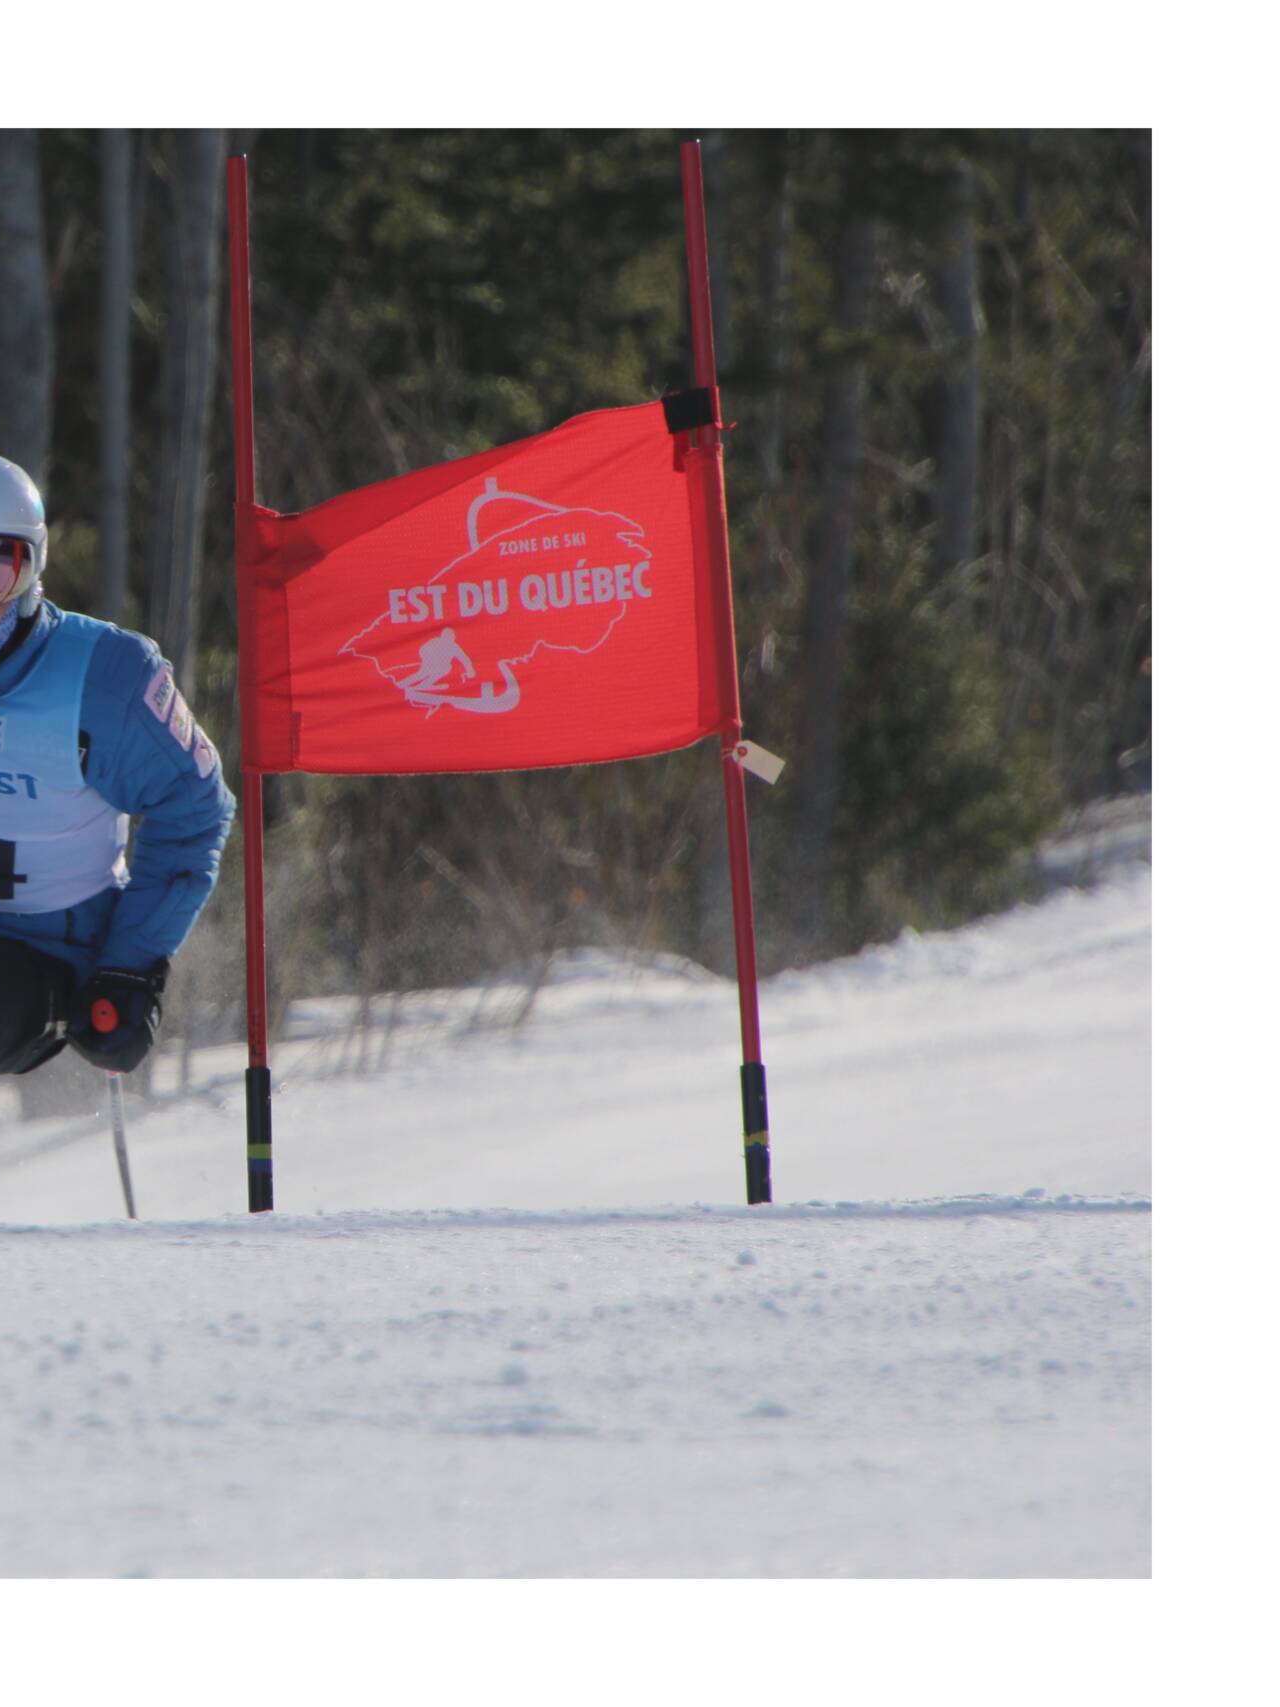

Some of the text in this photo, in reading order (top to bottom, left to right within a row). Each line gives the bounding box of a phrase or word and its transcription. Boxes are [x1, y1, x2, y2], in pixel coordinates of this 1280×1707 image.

[499, 532, 586, 556] ZONE DE SKI
[389, 559, 652, 624] EST DU QUÉBEC
